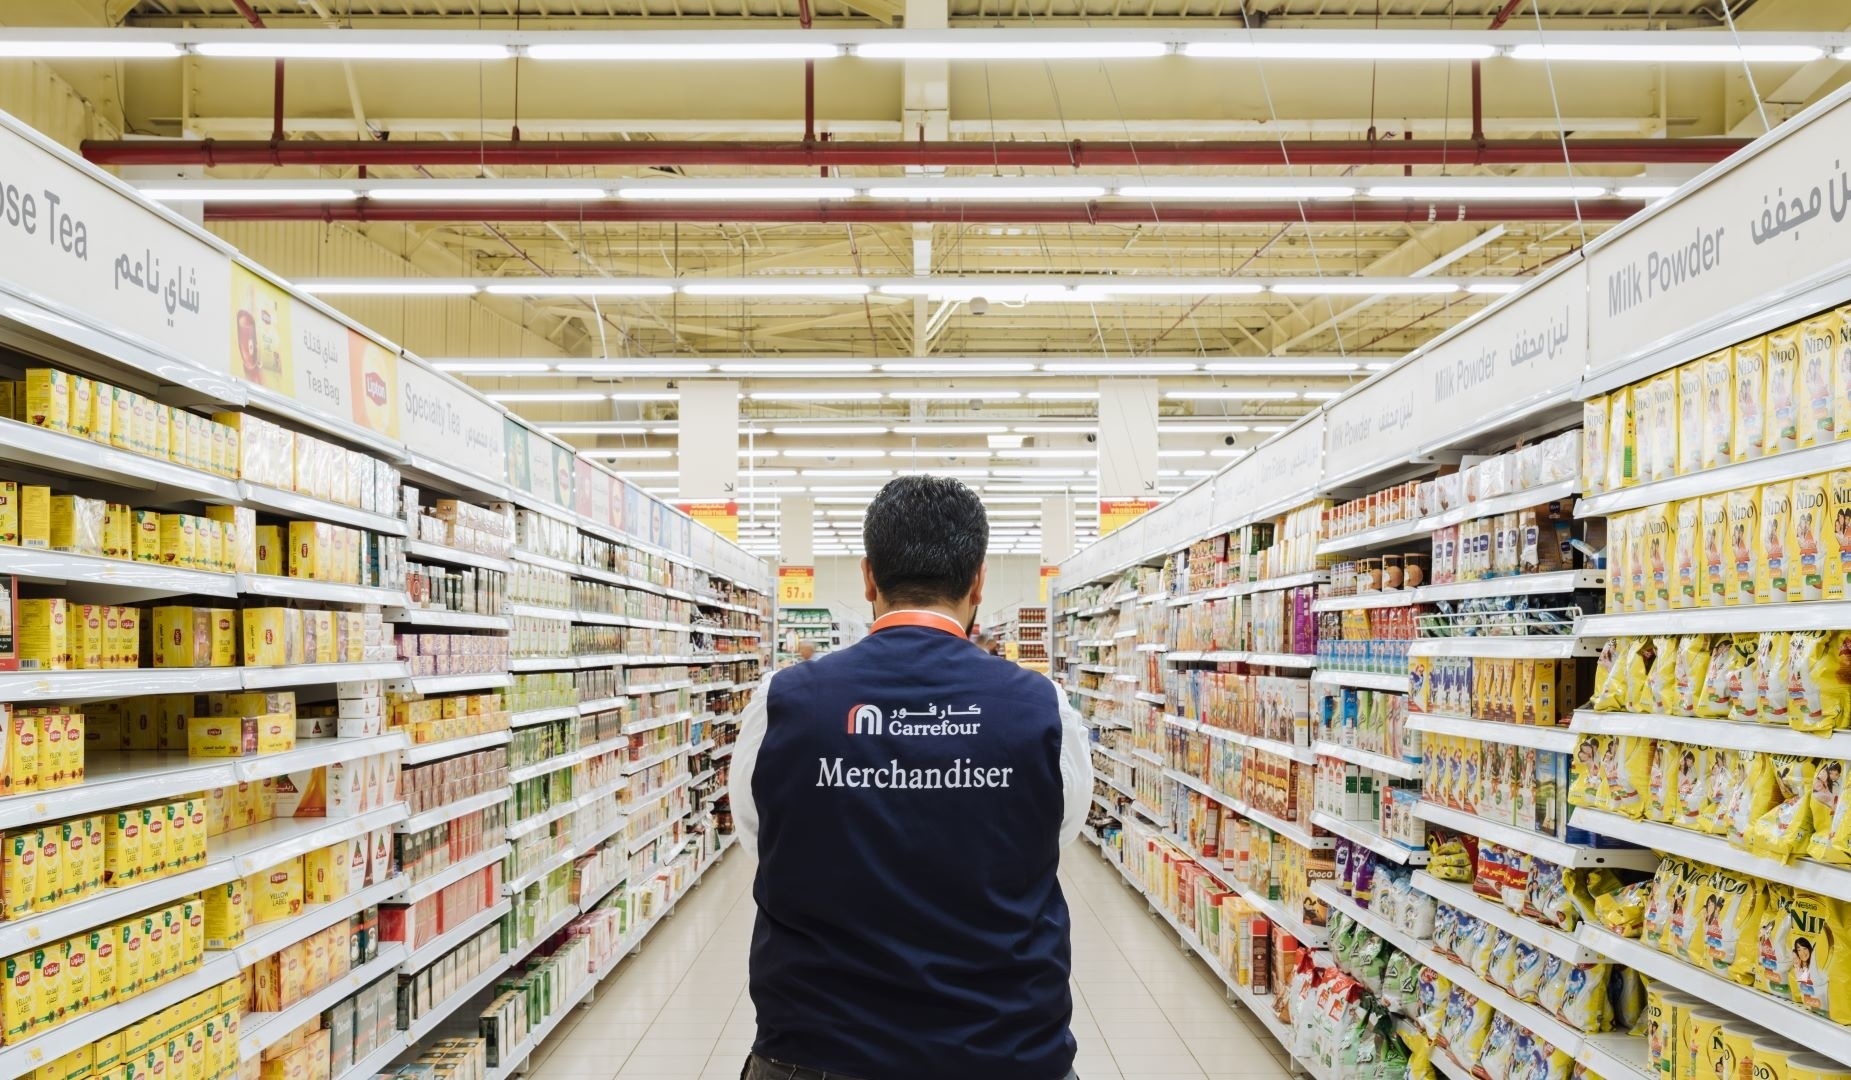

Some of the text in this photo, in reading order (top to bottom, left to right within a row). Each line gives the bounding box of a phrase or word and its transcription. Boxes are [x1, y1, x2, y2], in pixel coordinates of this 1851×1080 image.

[44, 190, 87, 261] Tea
[1751, 187, 1821, 246] مجفف
[1609, 226, 1724, 318] Milk Powder
[115, 248, 200, 327] شاي ناعم
[1510, 305, 1569, 369] لبن مجفف
[1805, 335, 1832, 355] NIDO
[1771, 347, 1795, 366] NIDO
[1434, 345, 1497, 403] Milk Powder
[306, 370, 340, 405] Tea Bag
[405, 382, 461, 436] Specialty Tea
[1765, 499, 1787, 516] NIDO
[1796, 493, 1823, 510] NIDO
[1731, 505, 1753, 521] NIDO
[890, 702, 981, 719] كارفور
[889, 720, 981, 736] Carrefour
[816, 757, 1013, 789] Merchandiser
[271, 874, 287, 882] Lipton
[270, 892, 288, 900] YELLOW
[16, 974, 30, 985] Lipton
